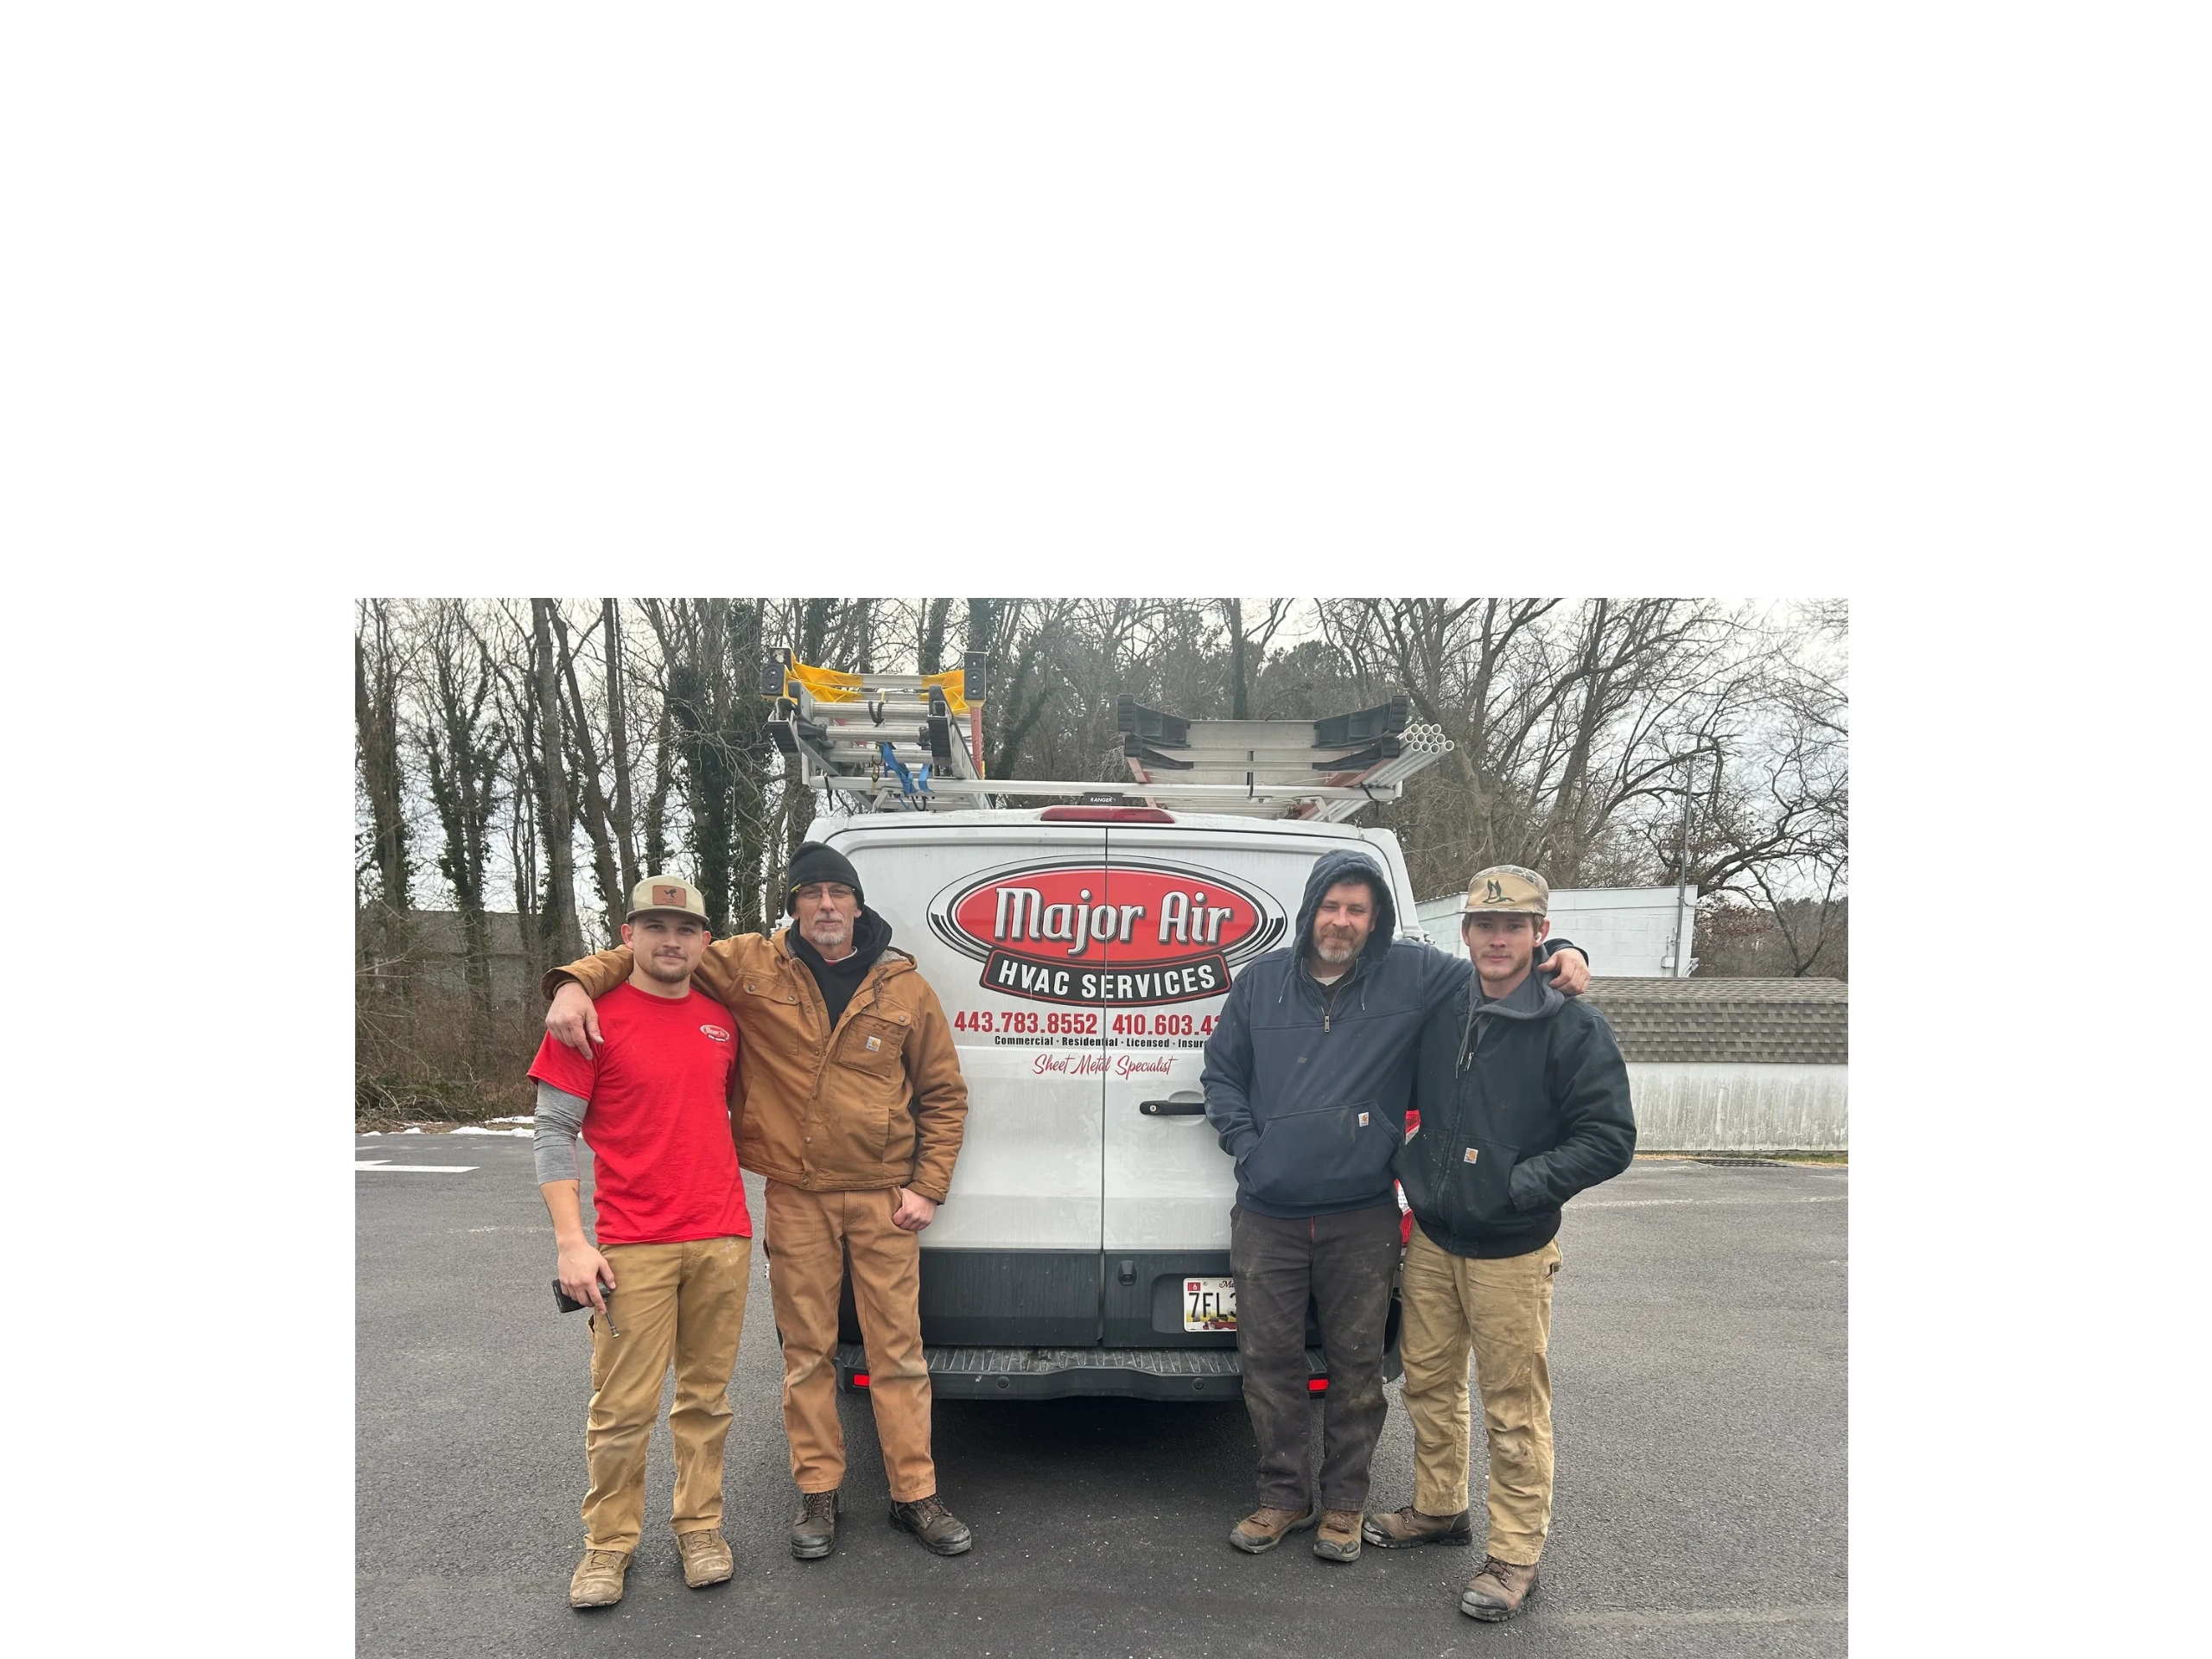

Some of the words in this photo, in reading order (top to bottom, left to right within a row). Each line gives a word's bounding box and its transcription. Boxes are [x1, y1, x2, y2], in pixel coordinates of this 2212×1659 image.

[995, 887, 1144, 955] Major
[1158, 891, 1232, 944] Air
[998, 960, 1070, 996] HVAC
[1082, 964, 1216, 999] SERVICES
[954, 1011, 1098, 1034] 443.783.8552
[995, 1035, 1053, 1046] Commercial
[1062, 1037, 1118, 1047] Residential
[1126, 1038, 1170, 1048] Licensed
[1178, 1039, 1207, 1048] Insur
[1032, 1053, 1076, 1075] Sheet
[1070, 1054, 1112, 1076] Metal
[1115, 1054, 1179, 1080] Specialist
